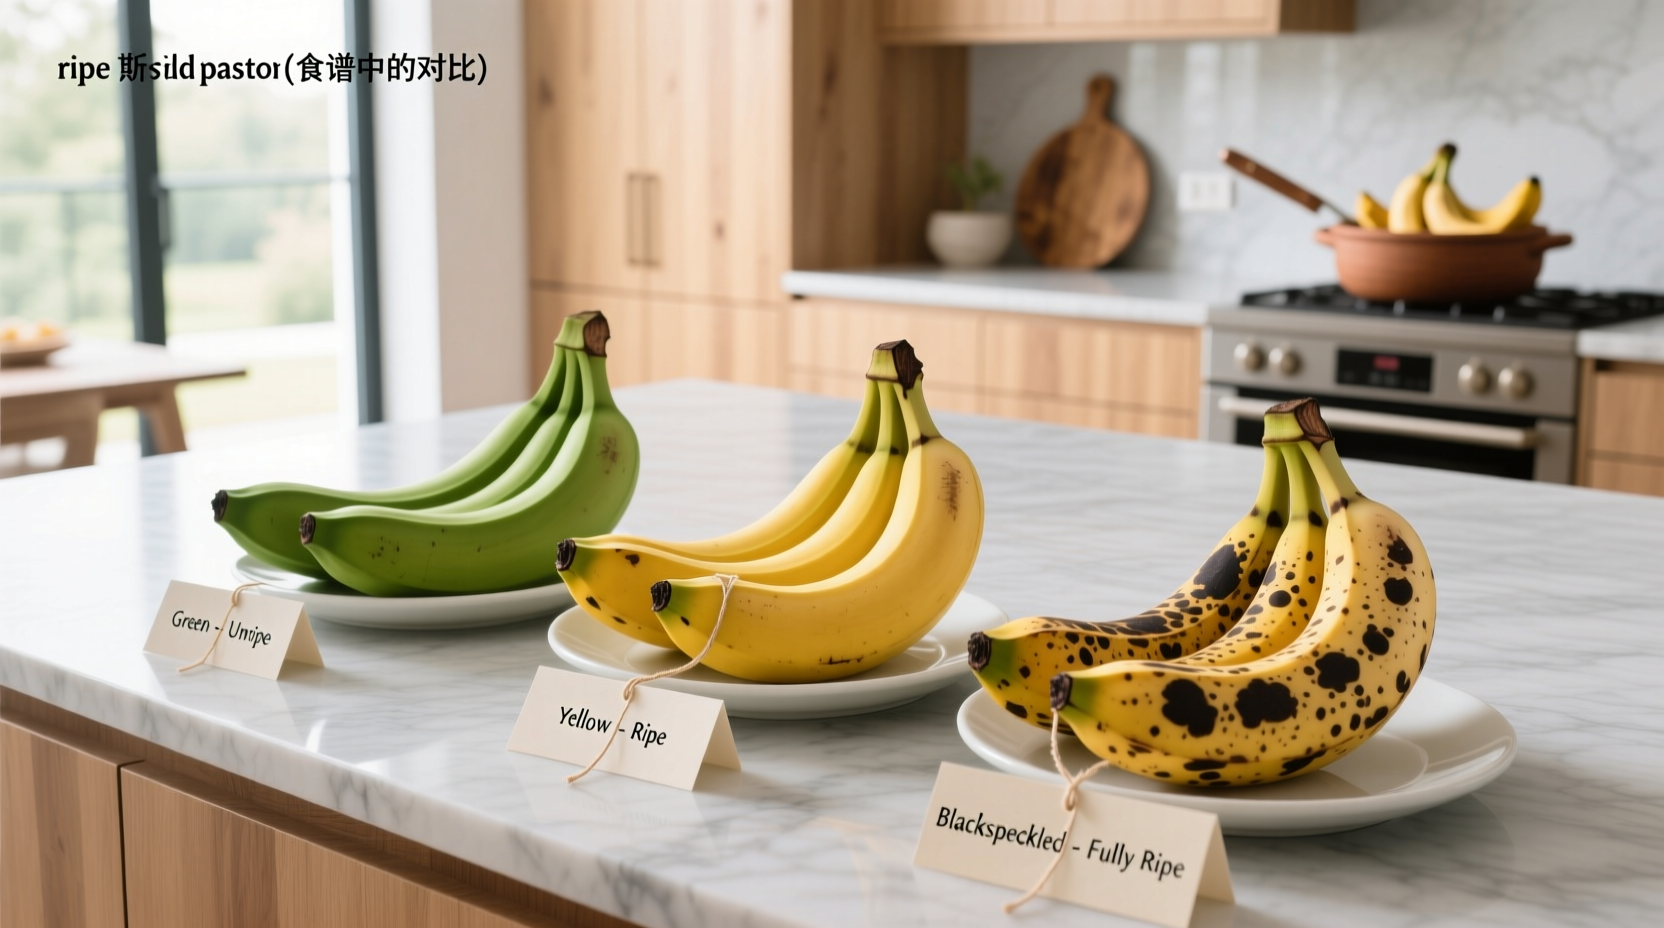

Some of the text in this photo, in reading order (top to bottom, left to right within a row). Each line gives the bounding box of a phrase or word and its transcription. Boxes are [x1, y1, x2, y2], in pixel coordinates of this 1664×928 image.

[171, 610, 210, 633] Green
[559, 706, 612, 734] Yellow
[630, 721, 667, 749] Ripe
[936, 806, 1067, 853] Blackspeckled
[1087, 838, 1135, 873] Fully
[1140, 849, 1185, 881] Ripe
